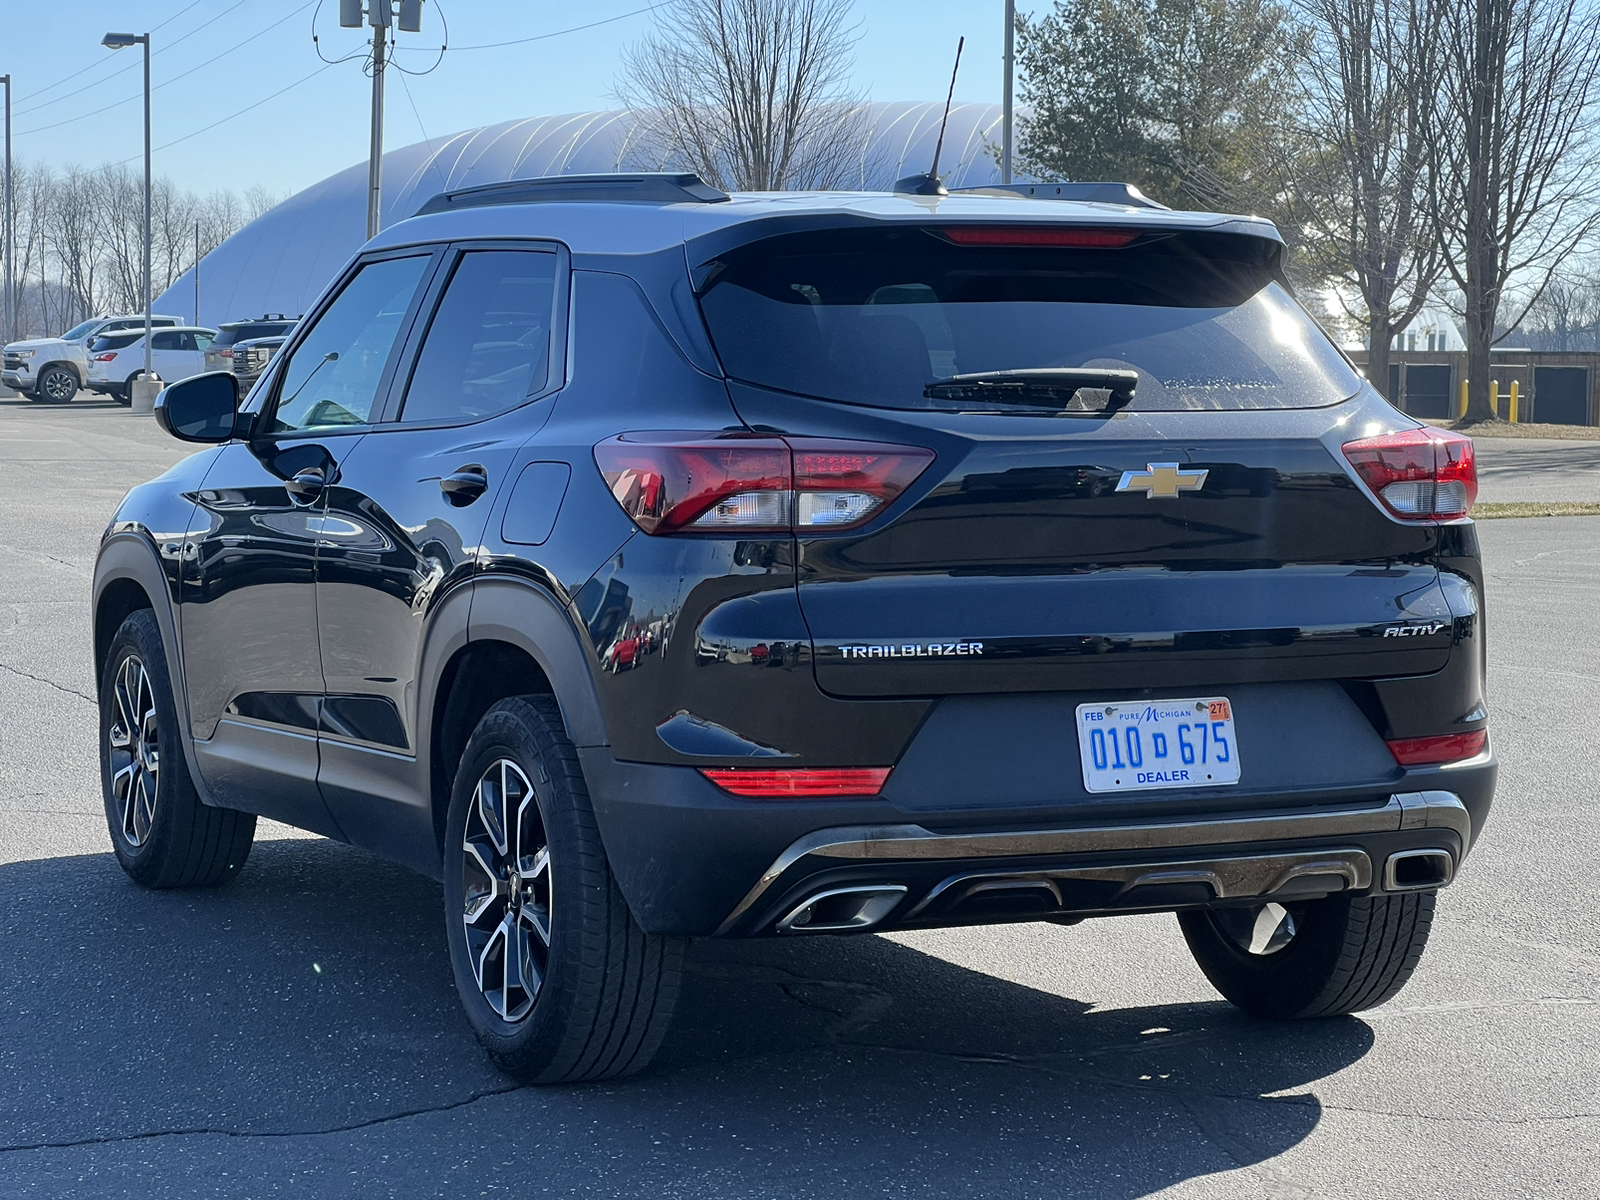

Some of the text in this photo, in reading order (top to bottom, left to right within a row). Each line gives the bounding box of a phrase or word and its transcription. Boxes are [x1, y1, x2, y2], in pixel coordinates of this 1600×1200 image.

[1382, 624, 1444, 638] ACTIV
[838, 642, 983, 659] TRAILBLAZER
[1119, 706, 1191, 725] PURE MICHIGAN
[1210, 703, 1222, 714] 27
[1085, 712, 1104, 721] FEB
[1091, 726, 1143, 770] 010
[1178, 721, 1230, 765] 675
[1137, 770, 1190, 783] DEALER
